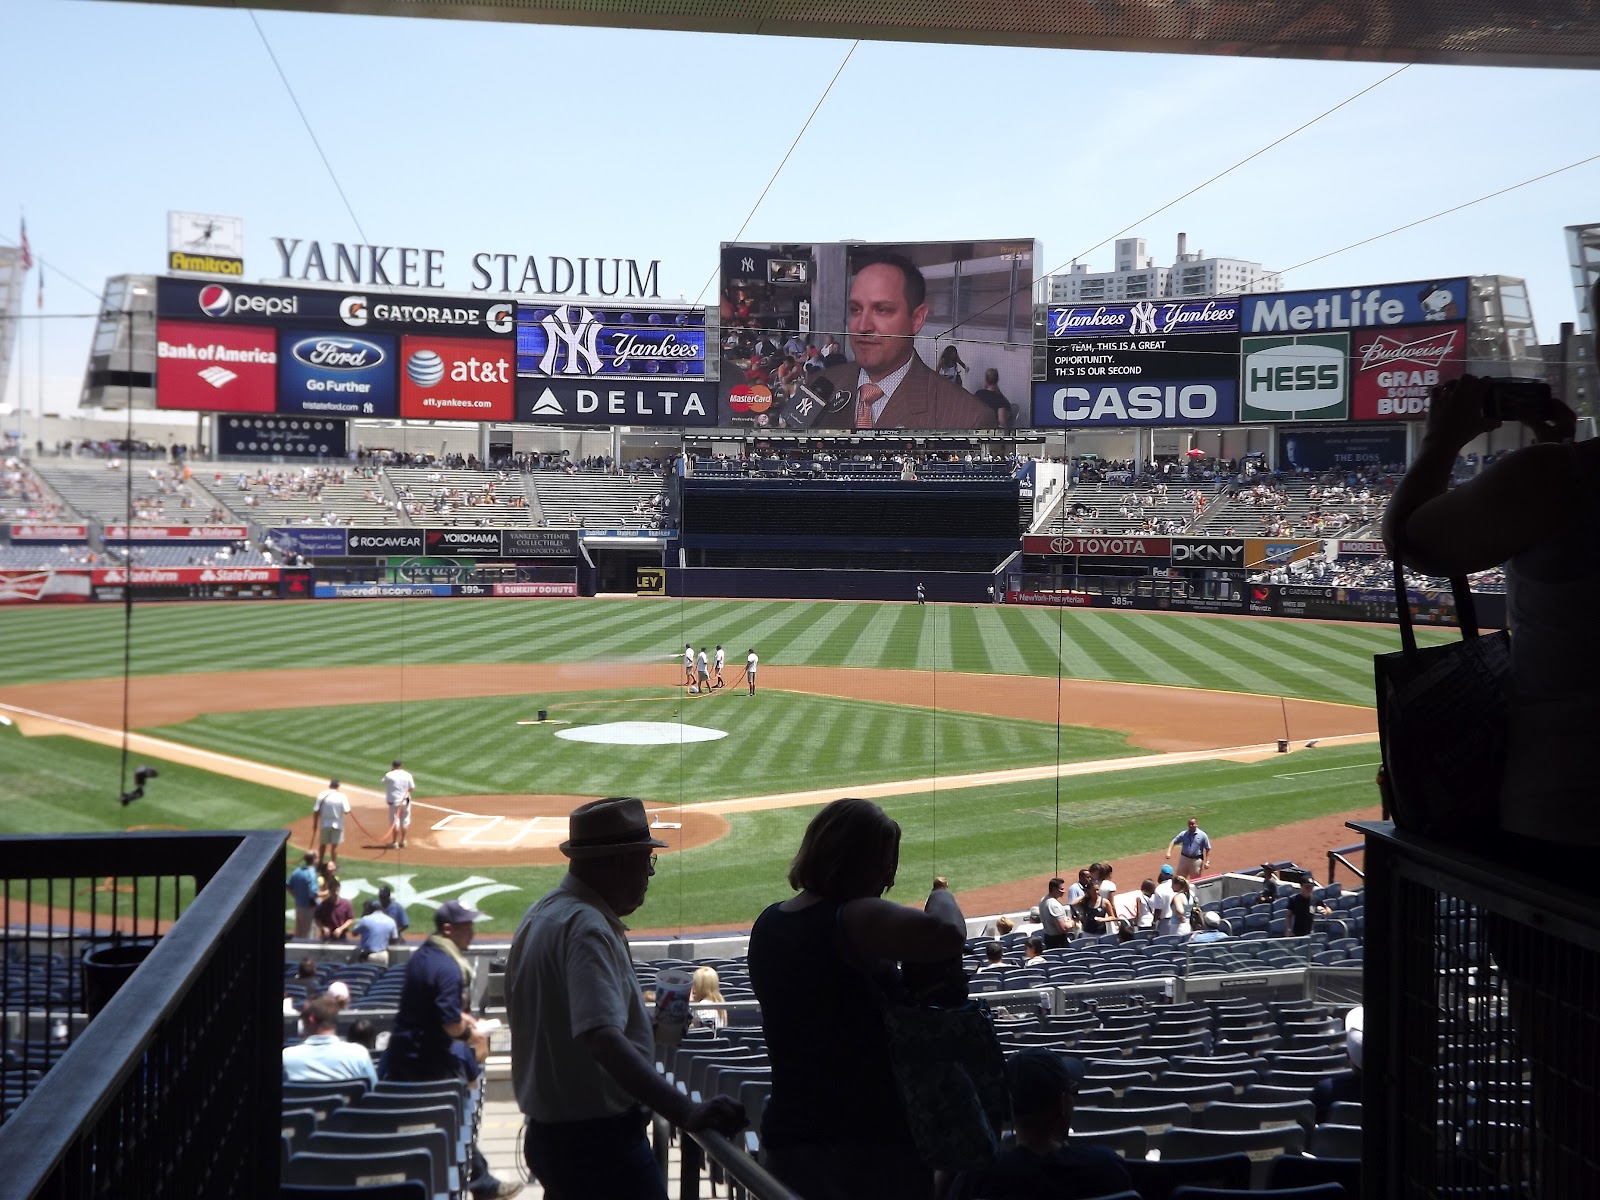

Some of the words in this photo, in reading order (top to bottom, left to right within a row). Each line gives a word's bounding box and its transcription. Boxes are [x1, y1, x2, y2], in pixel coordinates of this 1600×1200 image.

[172, 252, 243, 275] Armitron
[271, 237, 445, 288] YANKEE
[472, 252, 661, 298] STADIUM
[234, 294, 298, 316] pepsi
[374, 304, 480, 325] GATORADE
[1251, 289, 1404, 332] MetLife
[1054, 306, 1125, 336] Yankees
[1163, 301, 1235, 333] Yankees
[158, 341, 198, 358] Bank
[198, 344, 215, 360] of
[215, 346, 277, 364] America
[310, 340, 367, 366] Ford
[612, 333, 699, 367] Yankees
[1097, 342, 1117, 350] THIS
[1119, 342, 1129, 350] IS
[1138, 341, 1166, 349] GREAT
[1359, 342, 1454, 361] Budweiser
[450, 357, 510, 383] at&t
[1077, 367, 1086, 375] IS
[1088, 366, 1106, 375] OUR
[1108, 366, 1142, 375] SECOND
[1250, 364, 1339, 392] HESS
[1377, 369, 1439, 387] GRAB
[306, 379, 325, 391] Go
[326, 380, 371, 393] Further
[1388, 386, 1428, 397] SOME
[423, 397, 492, 409] att.yankees.com
[576, 389, 706, 415] DELTA
[729, 394, 772, 403] MasterCard
[1053, 384, 1217, 420] CASIO
[360, 536, 420, 547] ROCAWEAR
[444, 533, 499, 543] YOKOHAMA
[1077, 538, 1146, 554] TOYOTA
[1172, 543, 1244, 562] DKNY
[1265, 547, 1295, 561] SAP
[1153, 567, 1179, 577] FedEx
[539, 586, 574, 594] DONUTS
